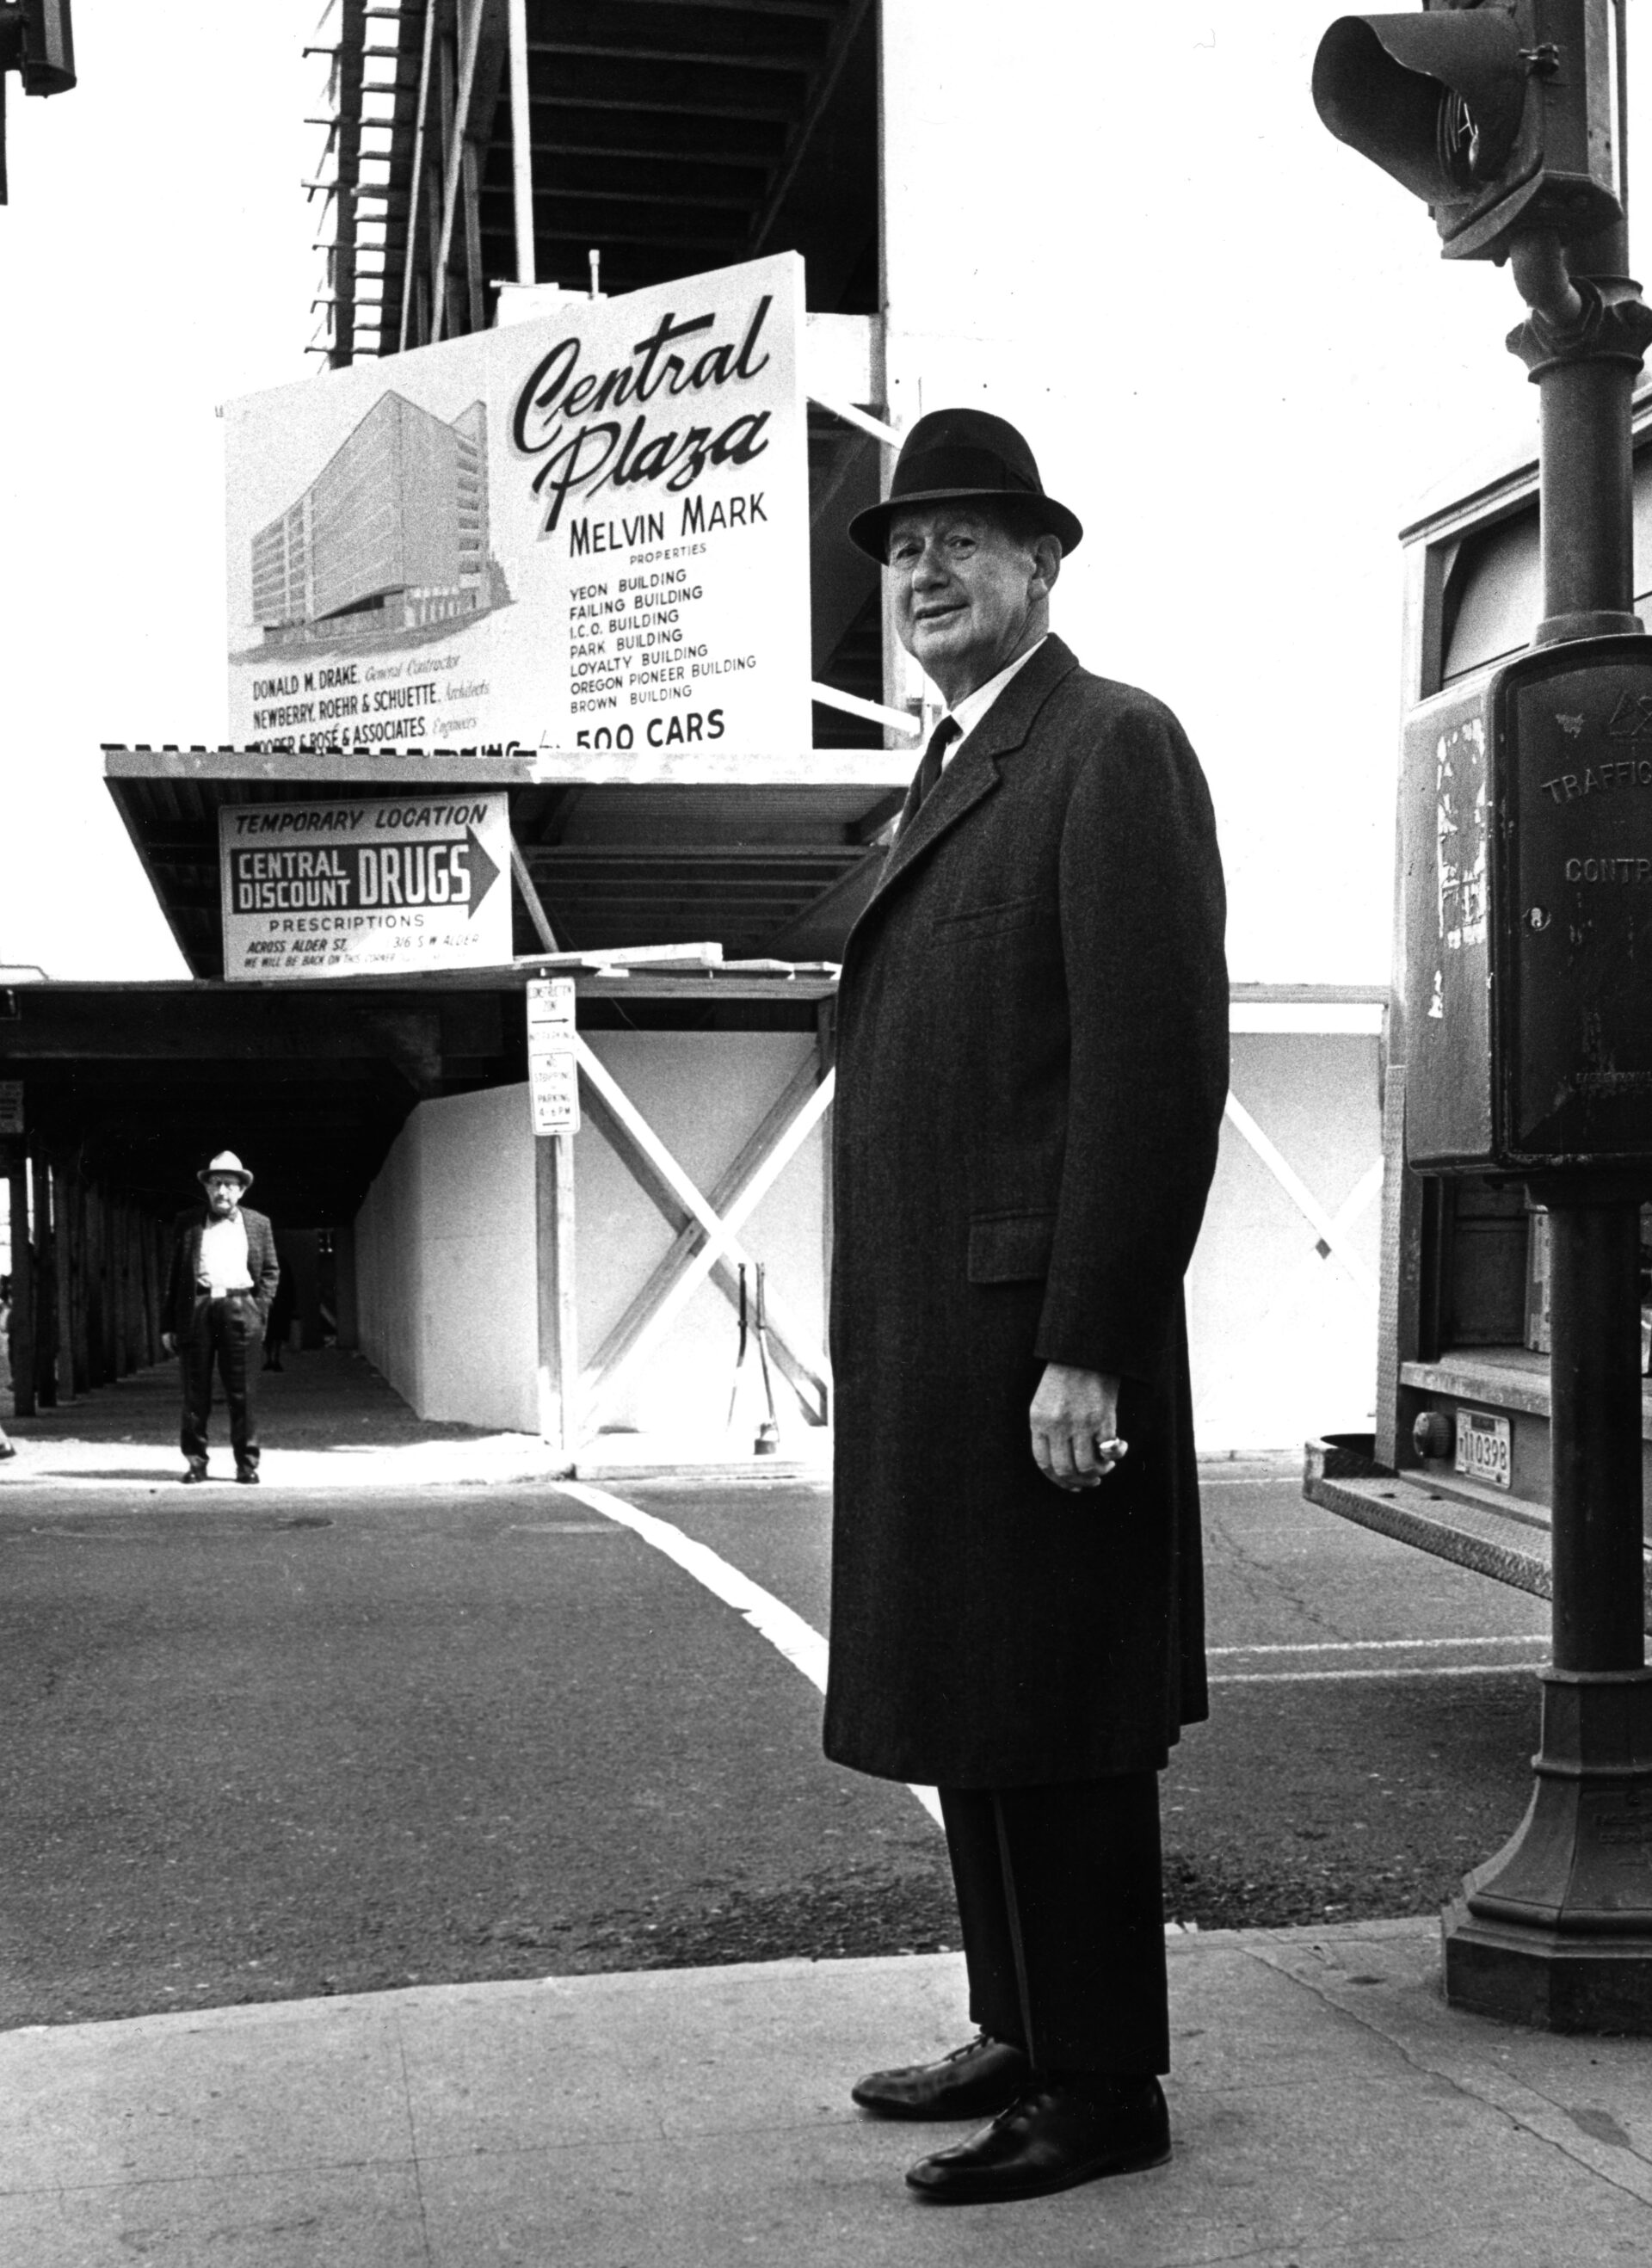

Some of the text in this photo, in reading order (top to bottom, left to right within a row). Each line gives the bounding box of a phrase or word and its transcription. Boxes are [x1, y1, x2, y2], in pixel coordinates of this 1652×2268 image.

[514, 295, 773, 453] Central
[532, 410, 772, 532] Plaza
[570, 492, 768, 558] MELVIN MARK
[630, 543, 706, 564] PROPERTIES
[570, 569, 687, 601] YEON BUILDING
[570, 585, 703, 620] FAILING BUILDING
[608, 609, 679, 632] BUILDING
[570, 629, 682, 659] PARK BUILDING
[570, 644, 708, 677] LOYALTY BUILDING
[570, 655, 756, 694] OREGON PIONEER BUILDING
[253, 675, 299, 700] DONALD
[570, 685, 693, 713] BROWN BUILDING
[319, 695, 358, 720] ROEHR
[361, 693, 370, 712] &
[342, 727, 349, 747] &
[576, 708, 725, 749] 500 CARS
[1539, 761, 1652, 804] TRAFFIC
[236, 804, 488, 835] TEMPORARY LOCATION
[238, 844, 472, 905] CENTRAL DRUGS
[239, 878, 351, 909] DISCOUNT
[269, 914, 424, 932] PRESCRIPTIONS
[244, 958, 256, 968] WE
[261, 957, 280, 968] WILL
[285, 955, 297, 967] BE
[302, 954, 324, 966] BACK
[328, 954, 340, 965] ON
[246, 940, 287, 954] ACROSS
[291, 937, 328, 952] ALDER
[537, 1093, 570, 1104] PARKING
[1464, 1432, 1507, 1470] 110398
